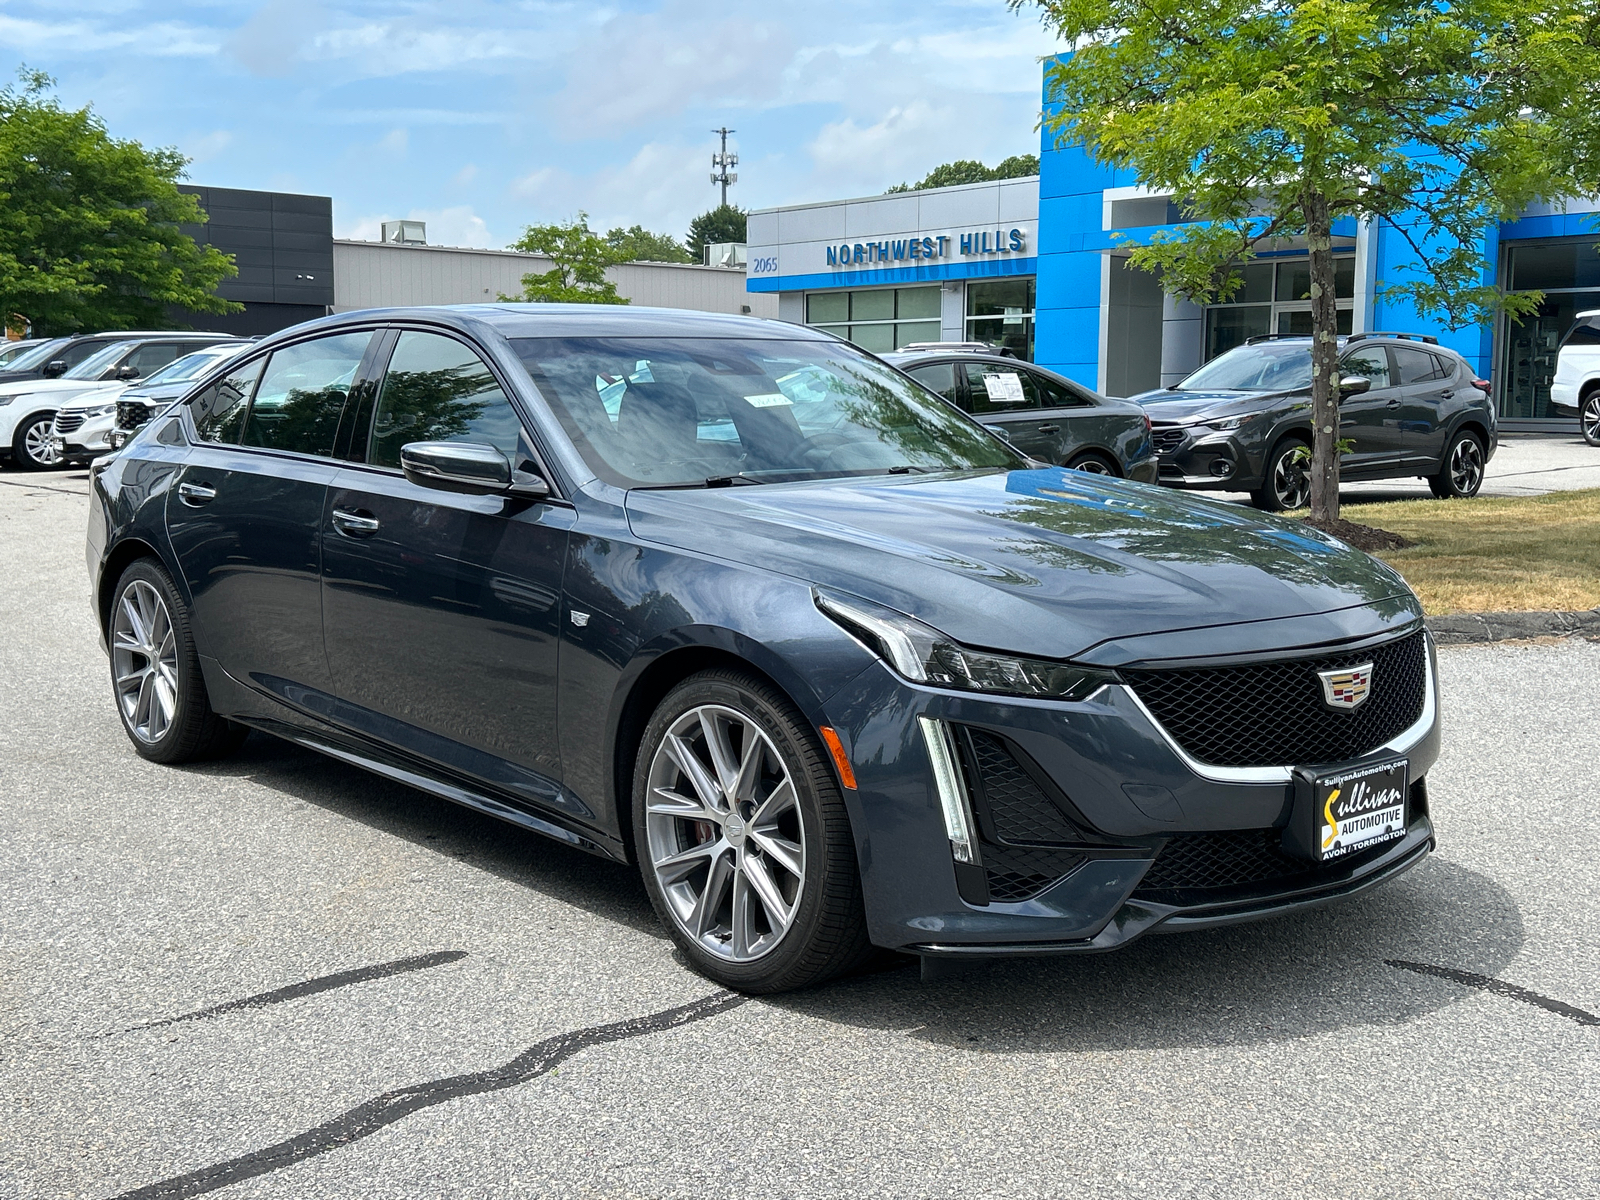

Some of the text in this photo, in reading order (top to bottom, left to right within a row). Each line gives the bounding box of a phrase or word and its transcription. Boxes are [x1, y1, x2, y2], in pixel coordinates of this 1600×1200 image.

[826, 228, 1022, 266] NORTHWEST HILLS
[753, 257, 778, 273] 2065
[753, 704, 808, 787] COOPER
[1324, 760, 1408, 786] SullivanAutomotive.com
[1323, 781, 1401, 848] Sullivan
[1342, 808, 1401, 836] AUTOMOTIVE
[1322, 847, 1347, 860] AVON
[1352, 828, 1407, 851] TORRINGTON
